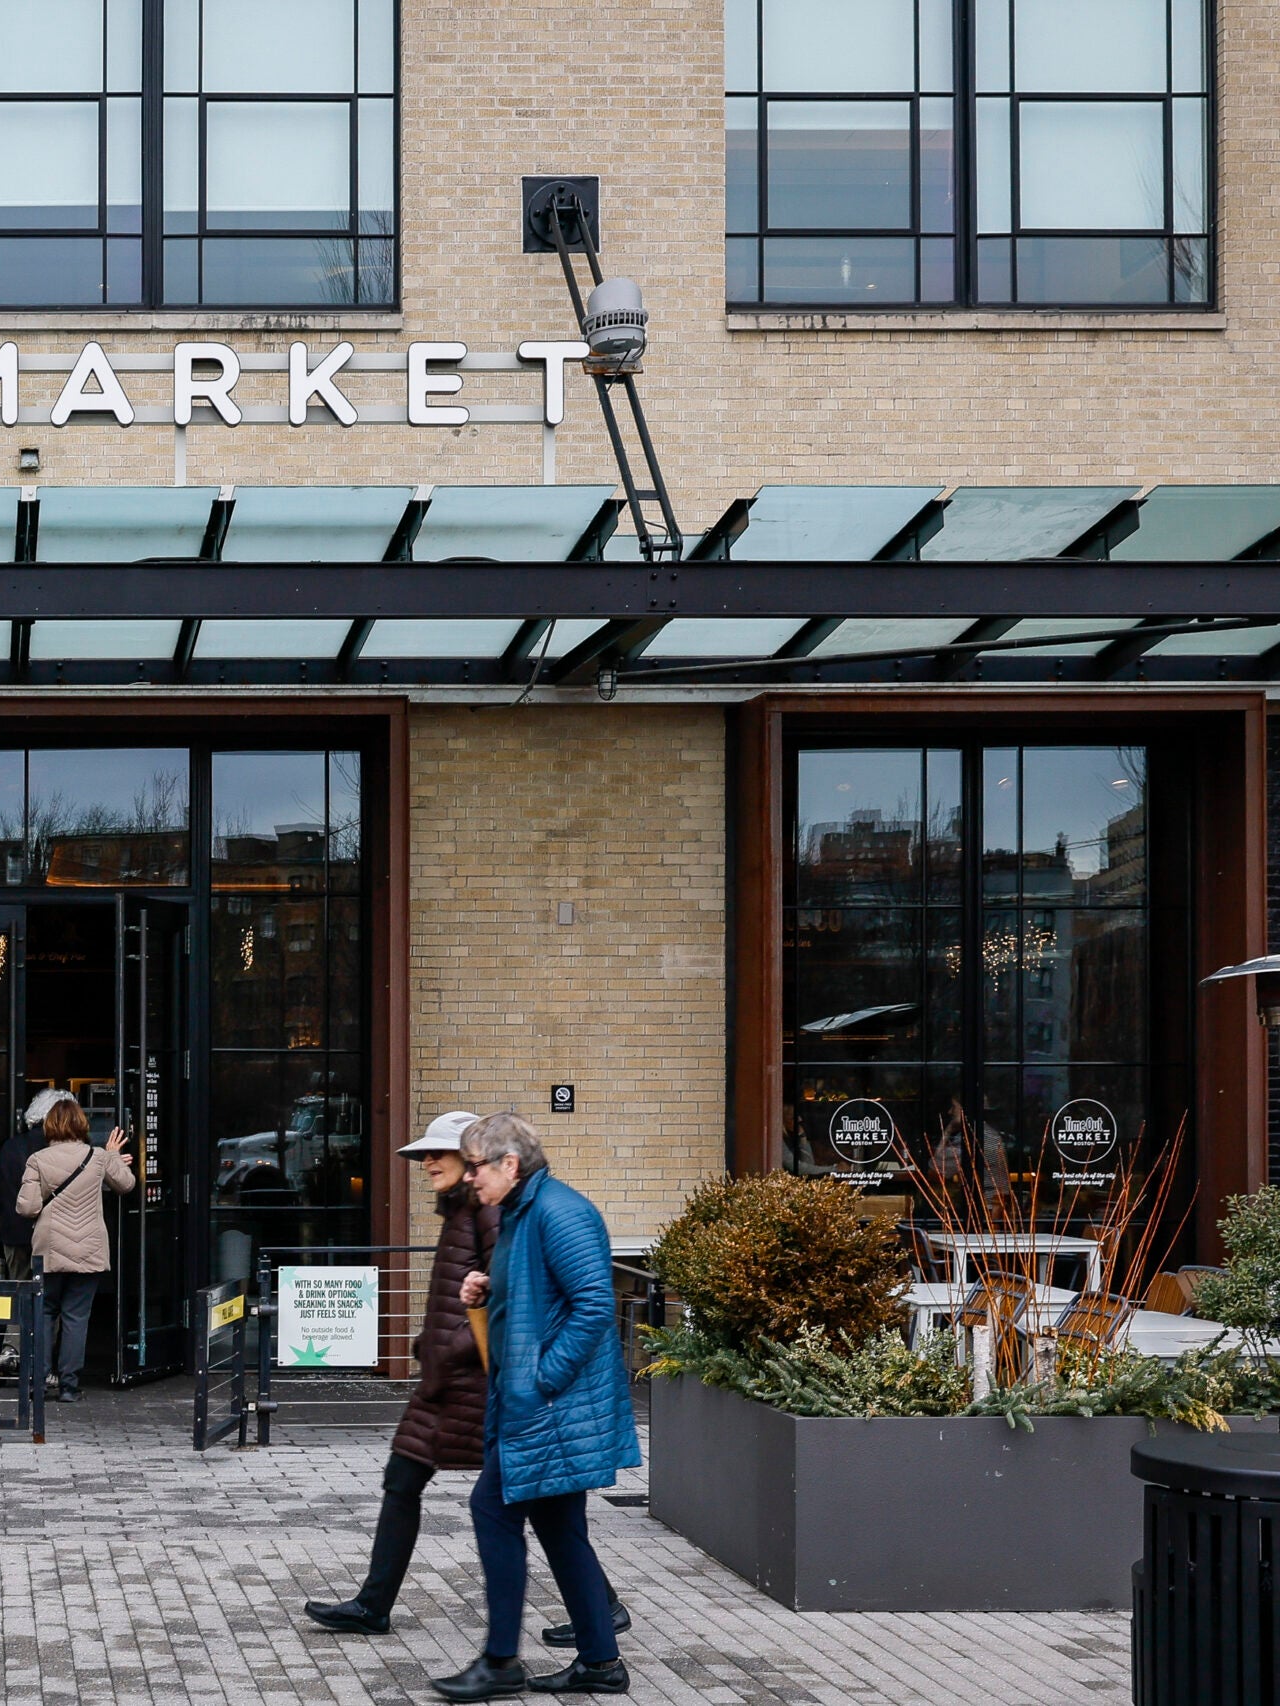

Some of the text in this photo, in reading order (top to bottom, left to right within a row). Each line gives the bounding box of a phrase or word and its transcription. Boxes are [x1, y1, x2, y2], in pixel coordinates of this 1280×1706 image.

[836, 1132, 887, 1140] MARKET
[1058, 1132, 1110, 1140] MARKET
[295, 1280, 362, 1288] WITH SO MANY FOOD
[299, 1290, 303, 1298] &
[306, 1290, 325, 1298] DRINK
[294, 1300, 363, 1308] SNEAKING IN SNACKS
[300, 1310, 314, 1318] JUST
[317, 1310, 336, 1318] FEELS
